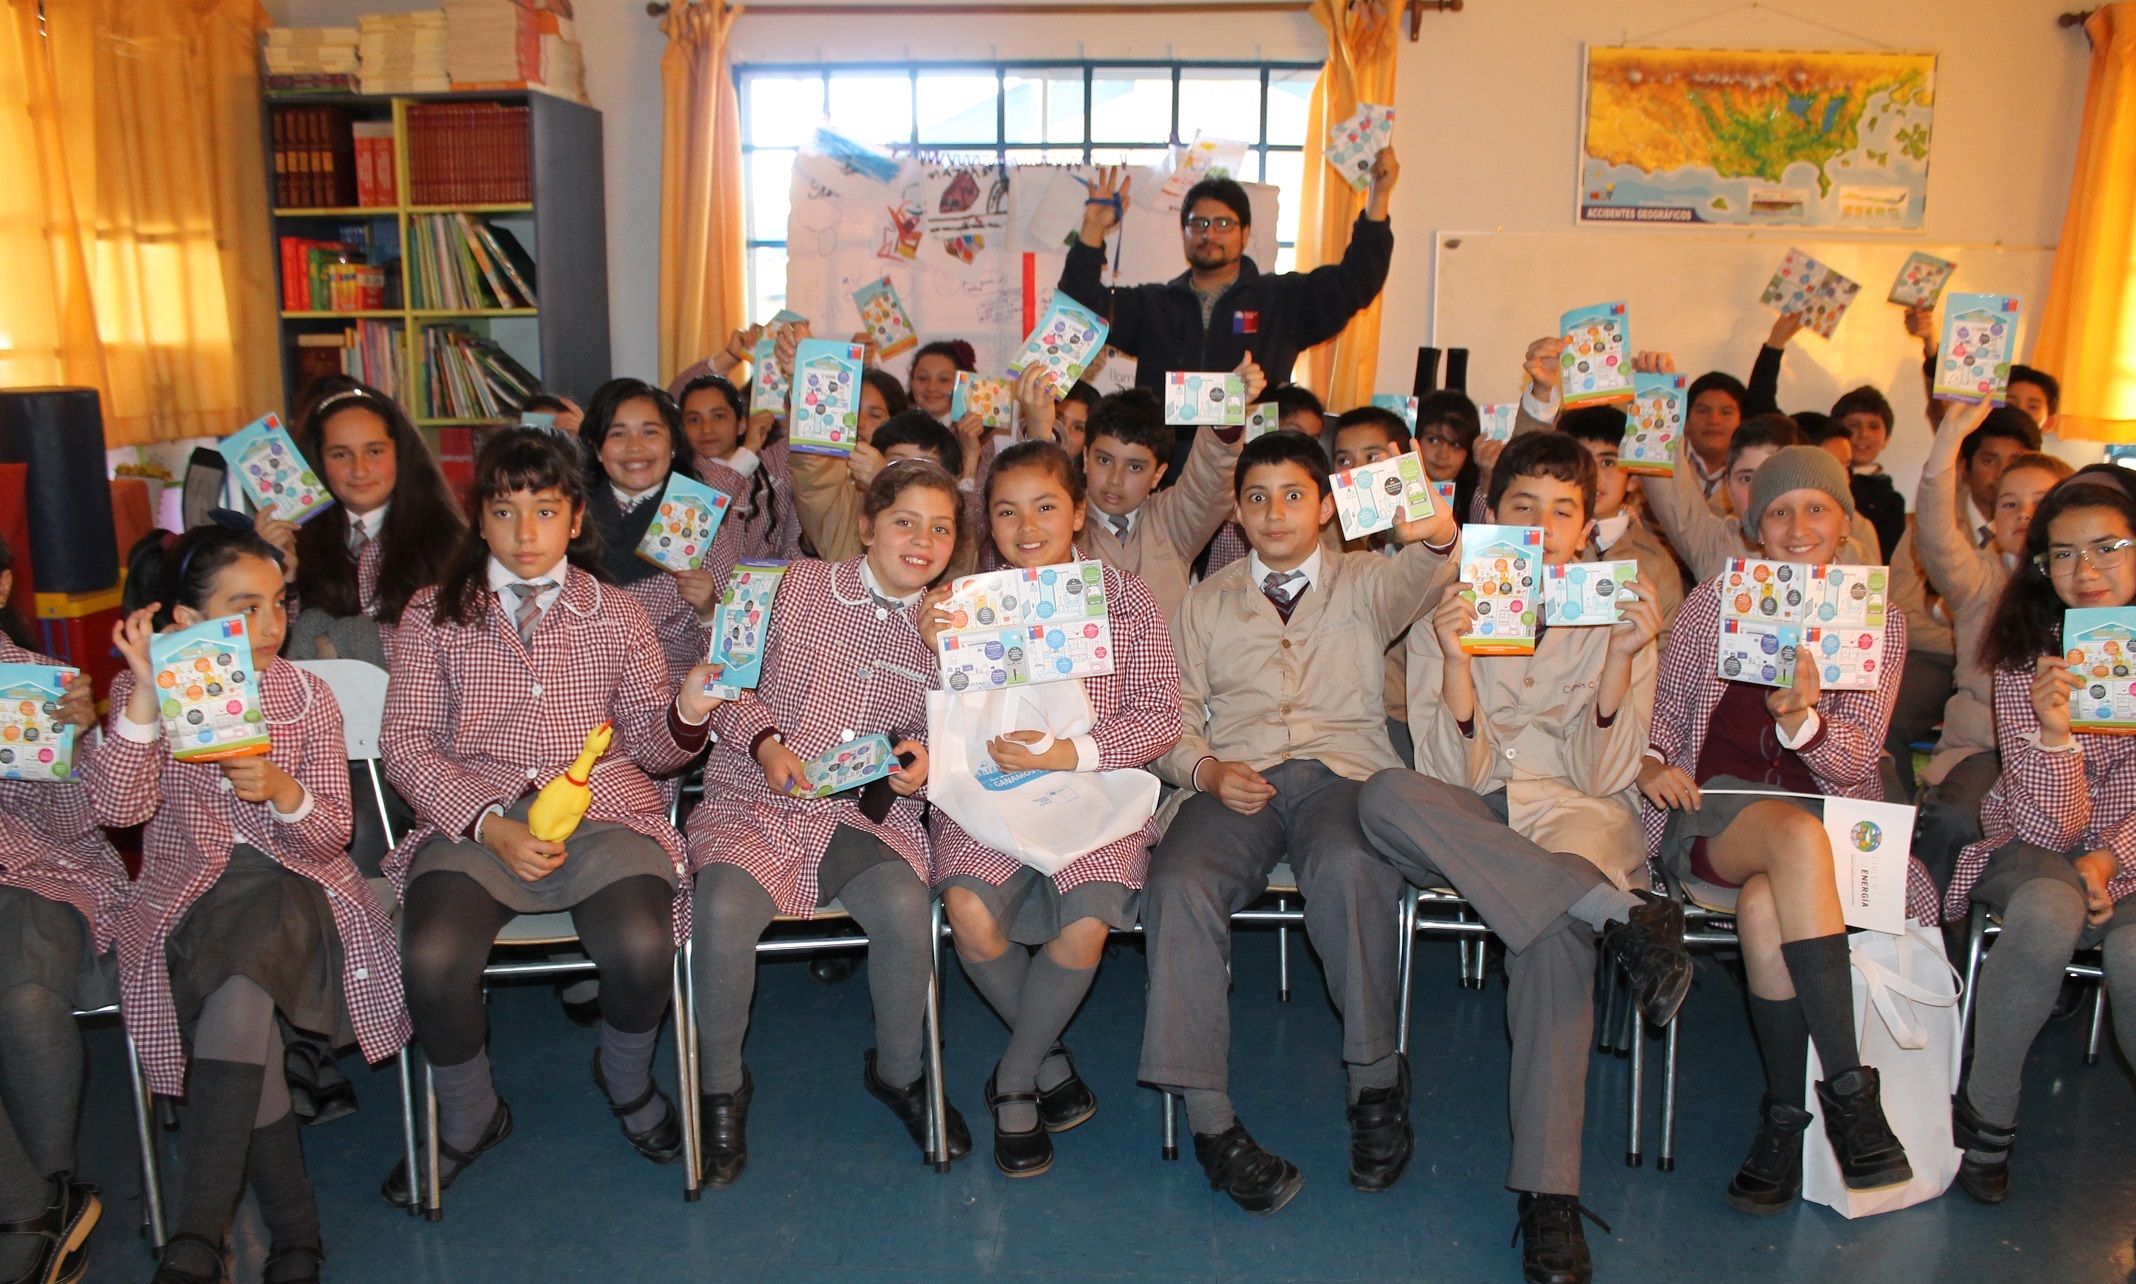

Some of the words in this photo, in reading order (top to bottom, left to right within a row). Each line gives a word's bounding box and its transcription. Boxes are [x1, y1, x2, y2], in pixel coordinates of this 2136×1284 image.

[1586, 207, 1636, 220] ACCIDENTES
[1637, 208, 1692, 221] GEOGRÁFICOS
[1861, 869, 1870, 908] ENERGÍA
